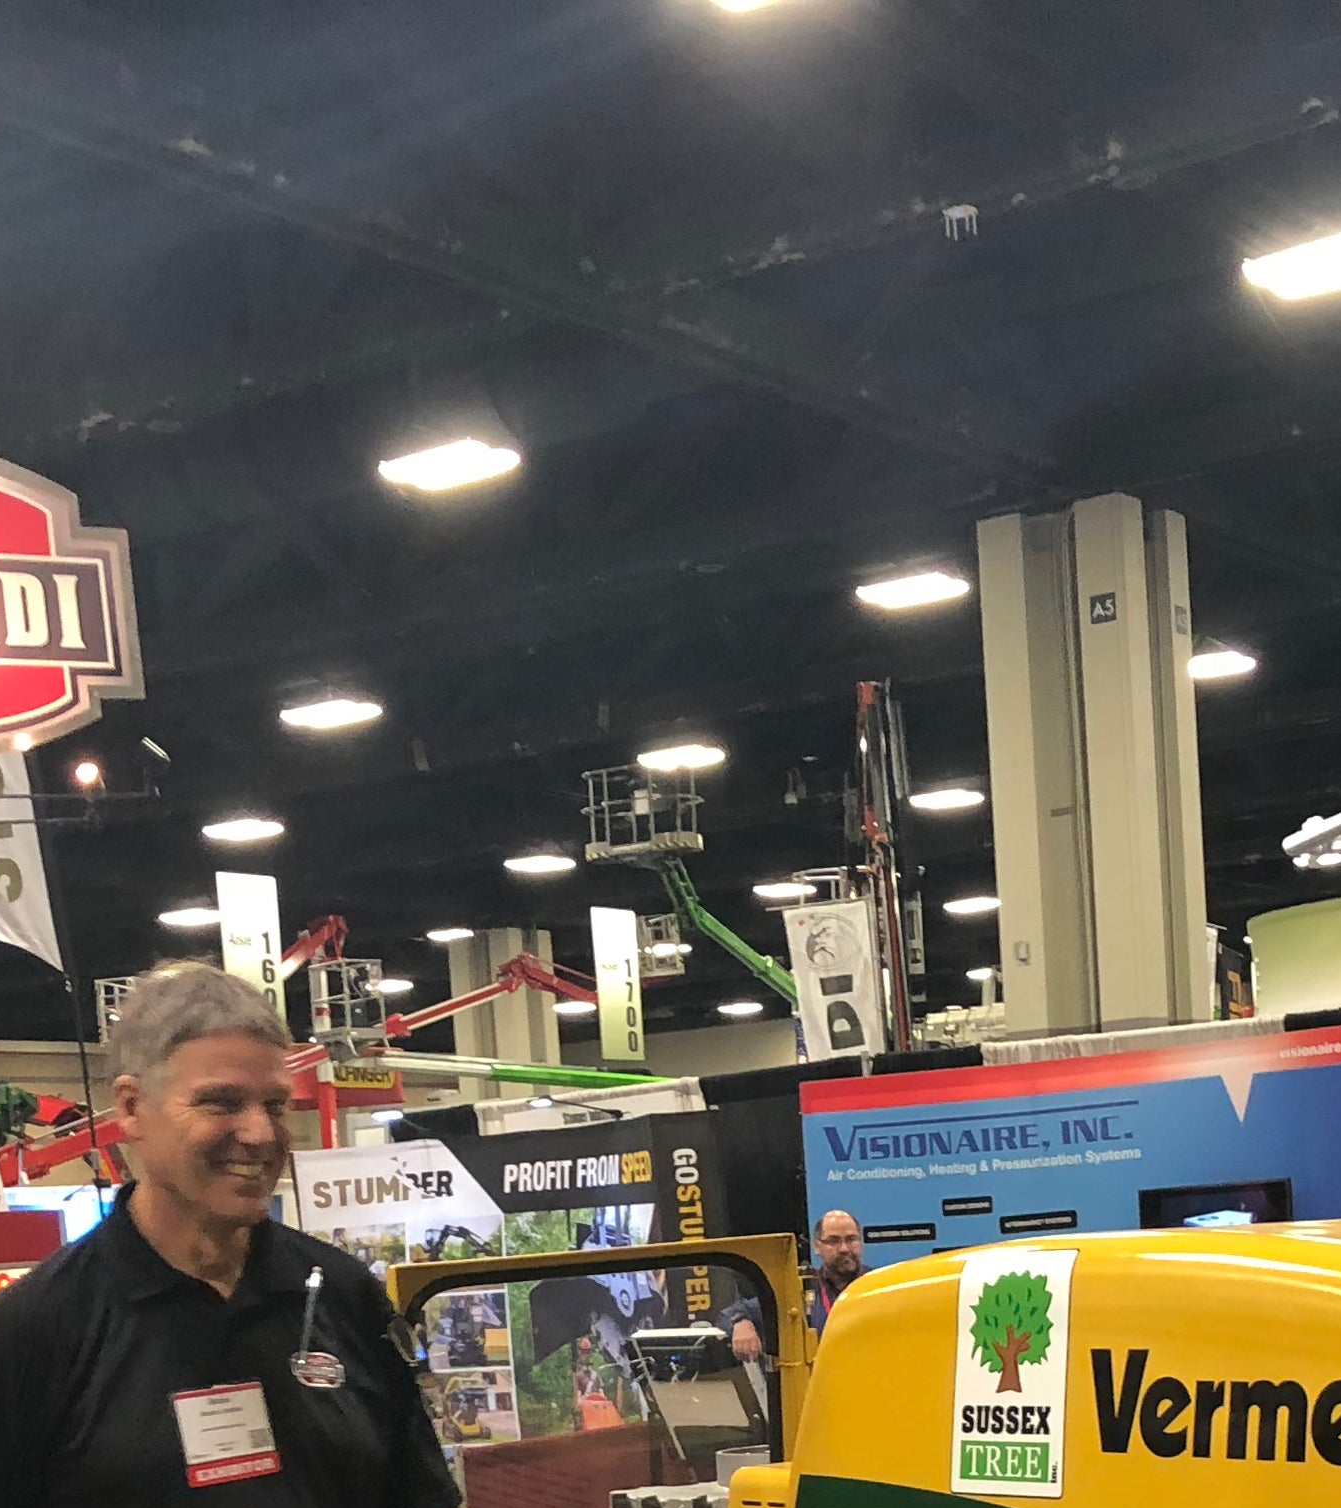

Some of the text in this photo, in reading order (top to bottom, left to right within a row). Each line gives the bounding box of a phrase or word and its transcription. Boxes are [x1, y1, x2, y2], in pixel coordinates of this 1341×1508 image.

[822, 1114, 1134, 1163] VISIONAIRE, INC.
[503, 1149, 654, 1194] PROFIT FROM SPEED
[827, 1168, 845, 1182] Air
[847, 1165, 927, 1181] Conditioning,
[929, 1161, 977, 1177] Heating
[979, 1159, 989, 1173] &
[1085, 1147, 1142, 1165] Systems
[961, 1405, 1052, 1435] SUSSEX
[965, 1444, 1043, 1479] TREE
